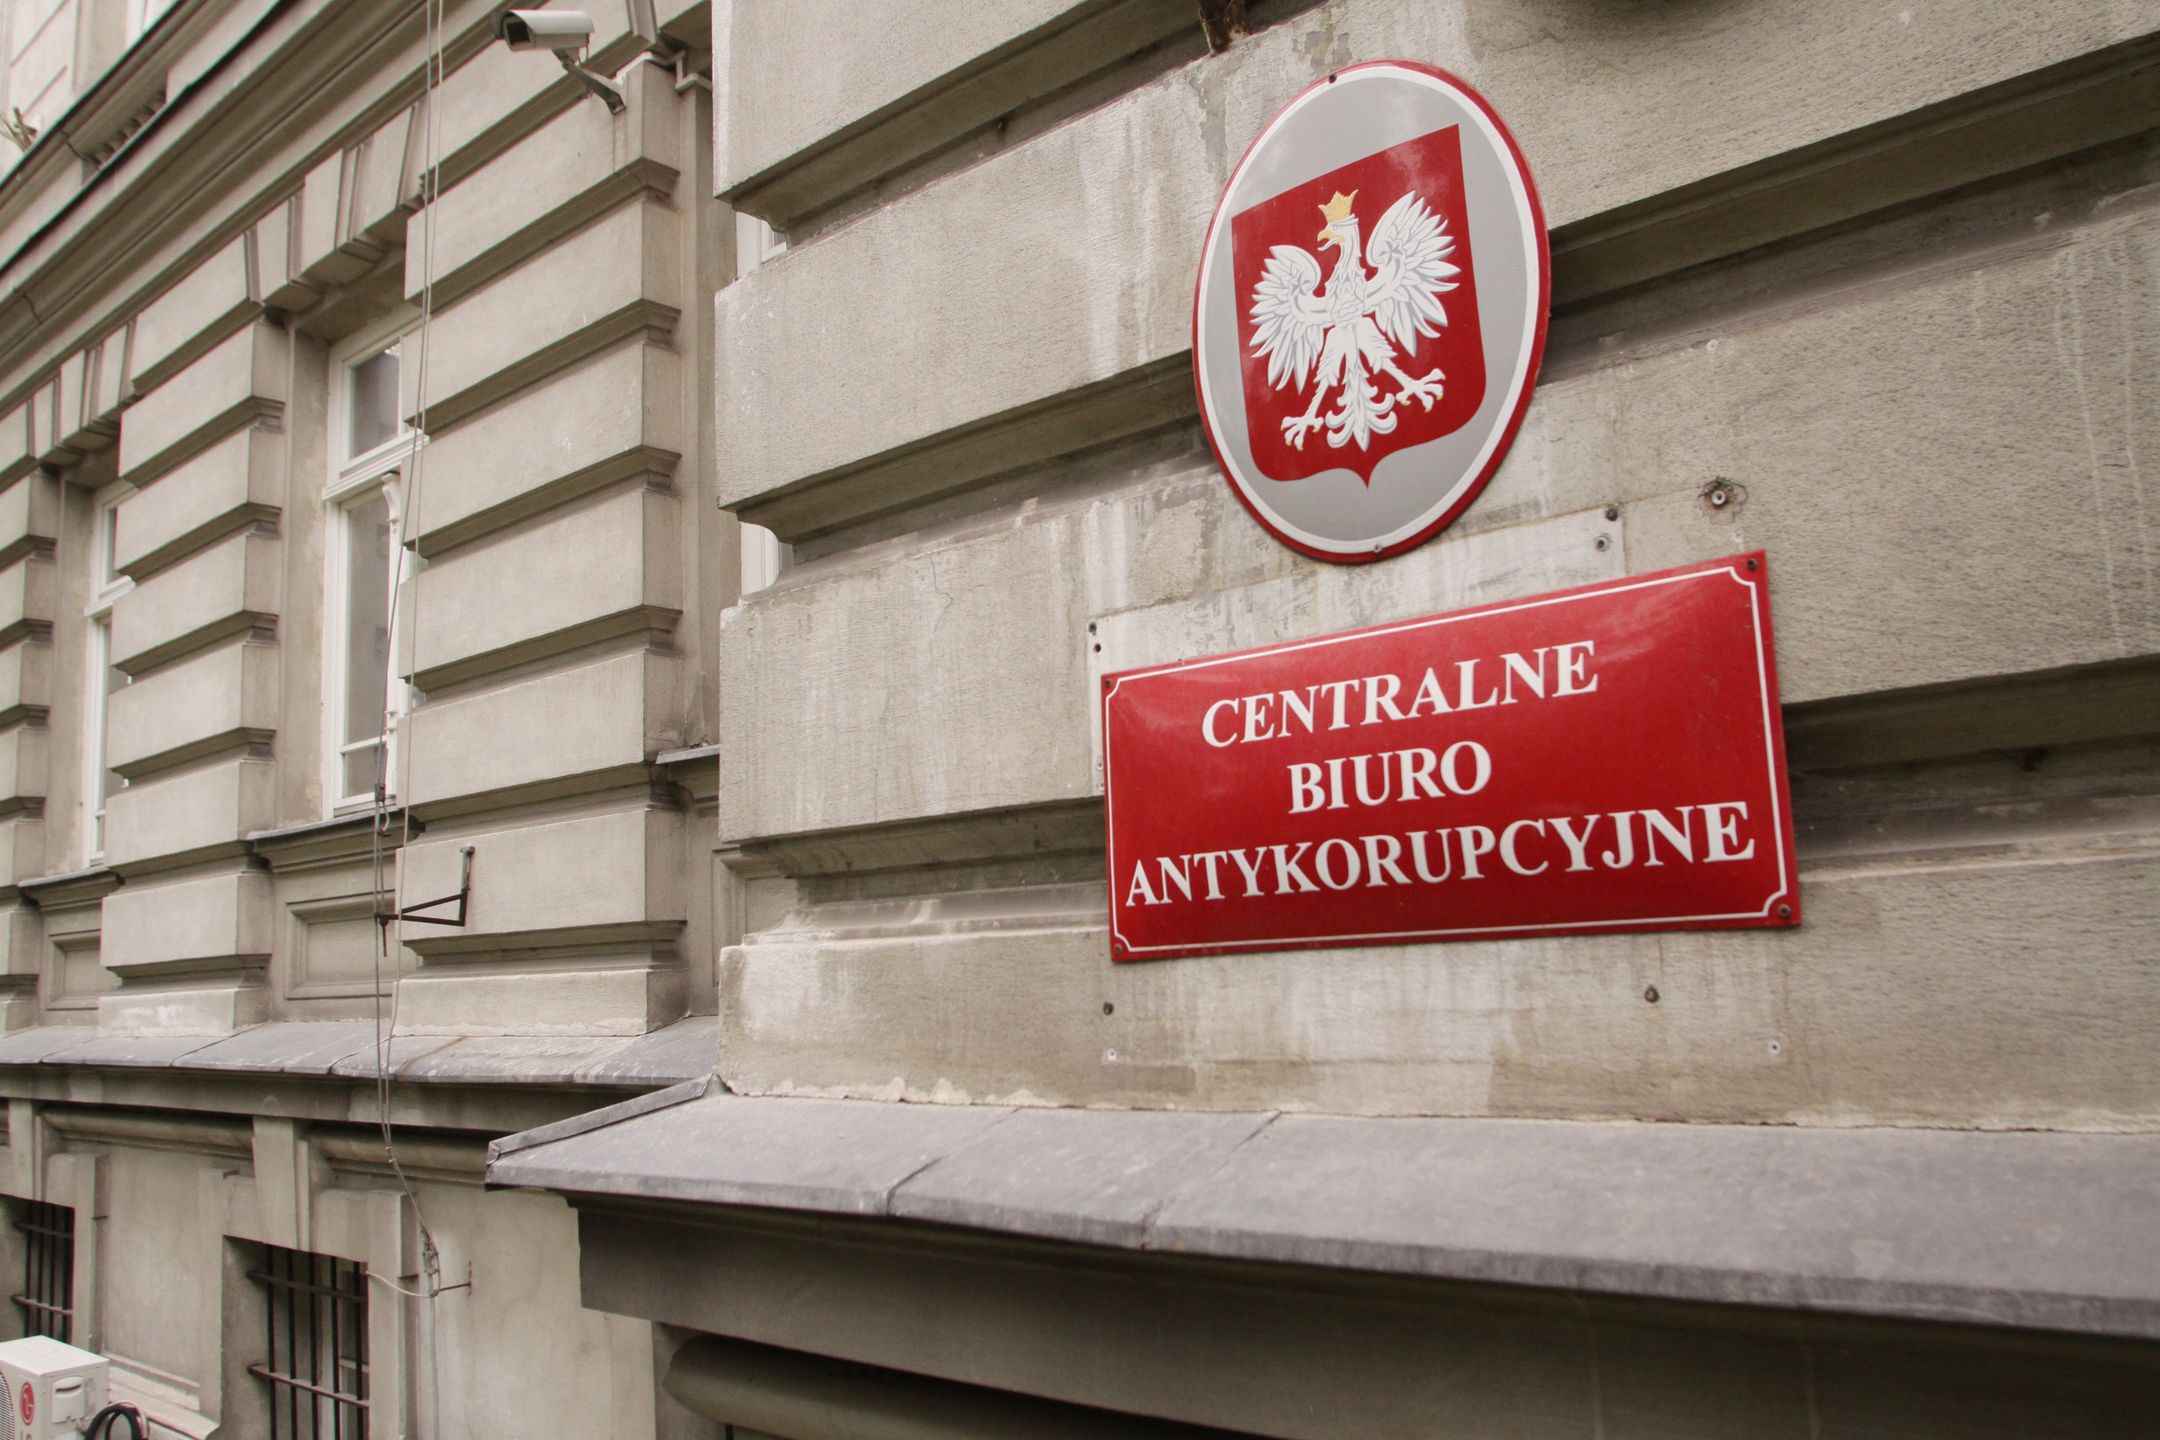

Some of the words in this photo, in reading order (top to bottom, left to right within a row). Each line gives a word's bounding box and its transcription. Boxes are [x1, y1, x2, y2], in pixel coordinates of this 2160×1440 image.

[1201, 639, 1599, 748] CENTRALNE
[1286, 740, 1492, 814] BIURO
[1125, 801, 1755, 907] ANTYKORUPCYJNE
